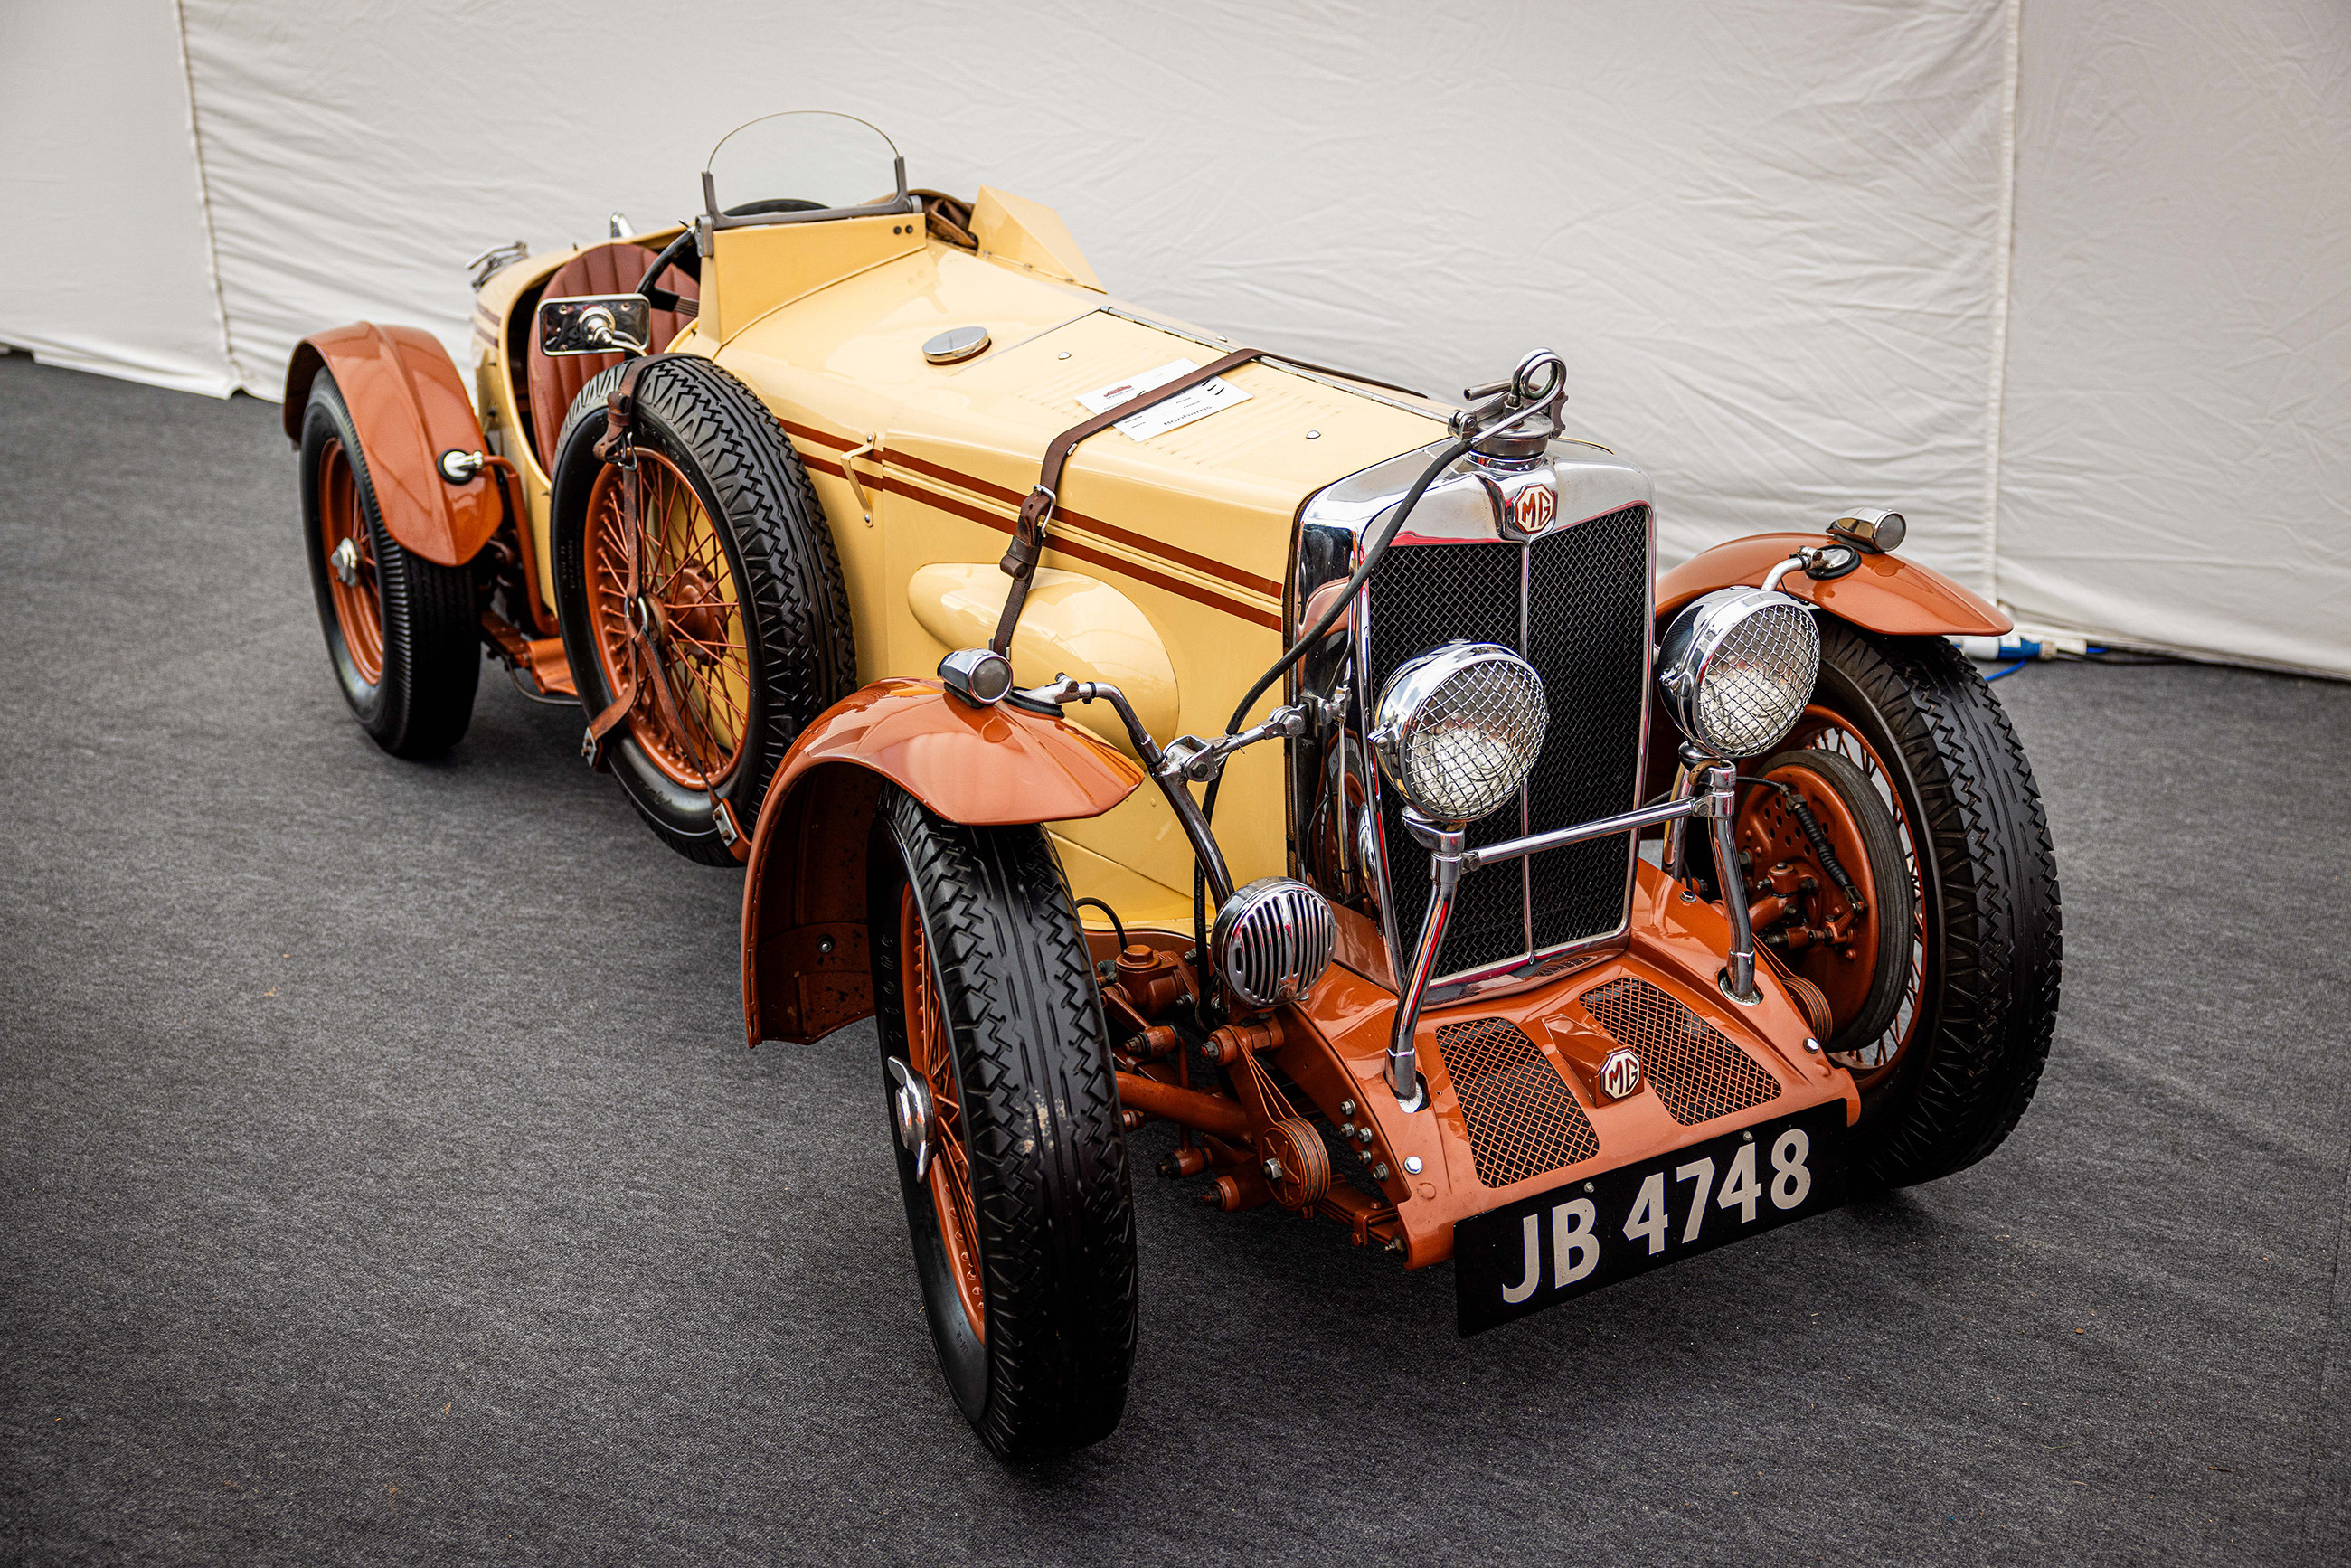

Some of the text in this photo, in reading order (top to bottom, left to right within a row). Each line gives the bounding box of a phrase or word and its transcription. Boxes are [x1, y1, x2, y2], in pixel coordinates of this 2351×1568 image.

[1520, 490, 1552, 529] MG
[1608, 1056, 1639, 1096] MG
[1502, 1128, 1812, 1304] JB 4748
